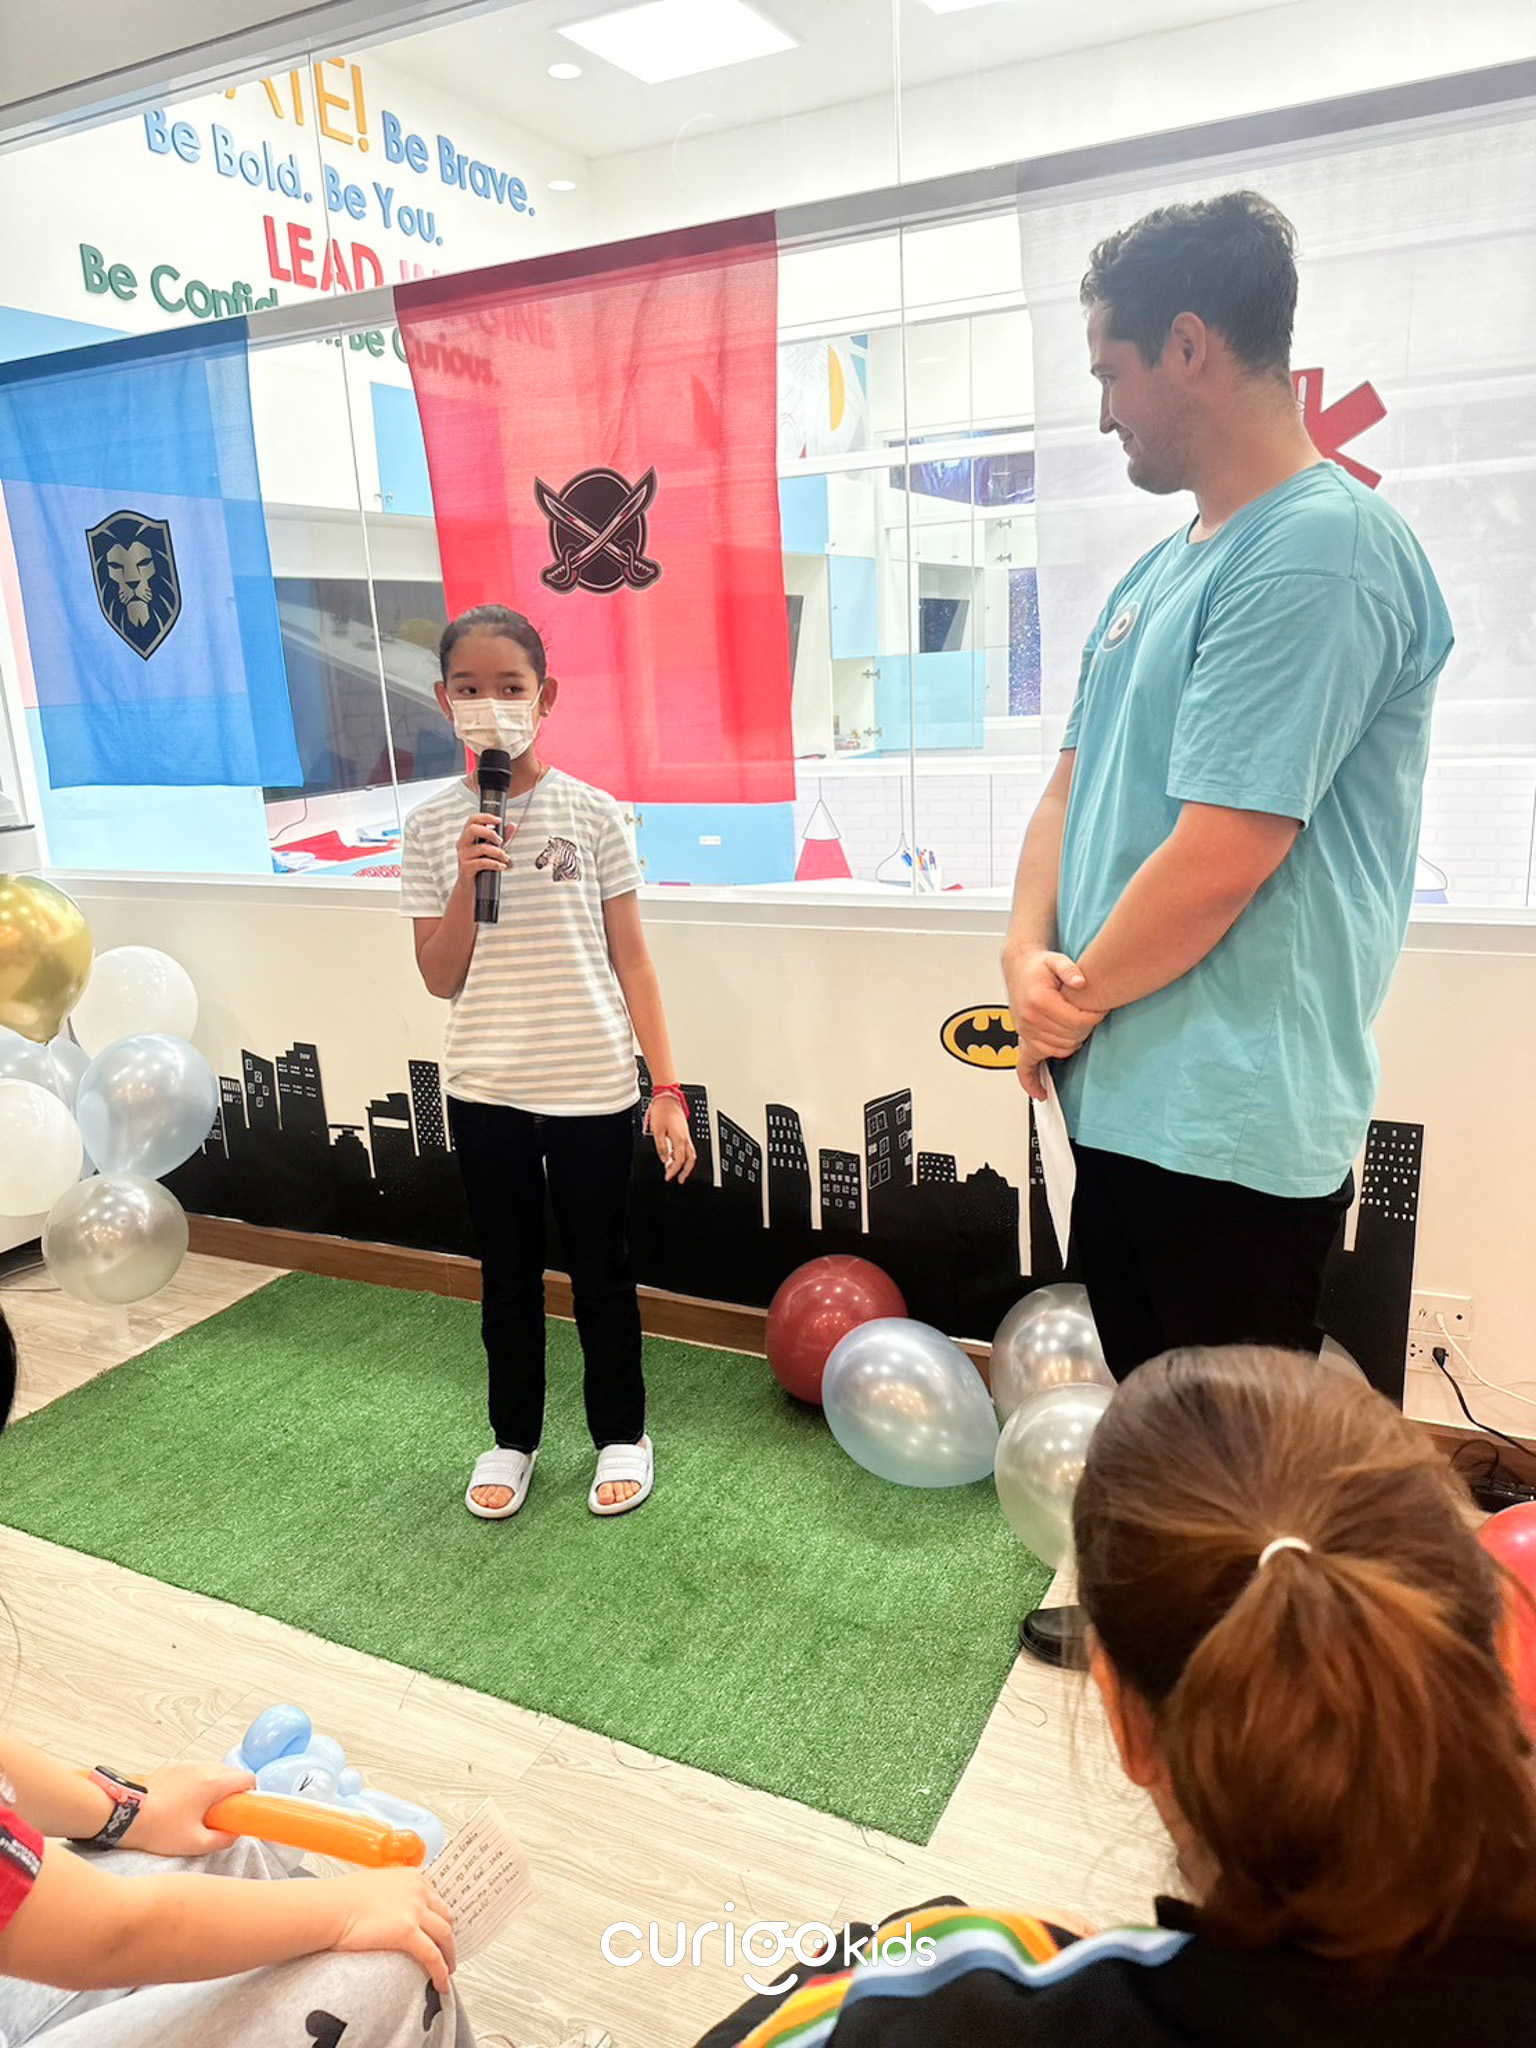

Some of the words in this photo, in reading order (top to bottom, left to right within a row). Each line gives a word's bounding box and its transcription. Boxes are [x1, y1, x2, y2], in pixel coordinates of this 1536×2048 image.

[144, 108, 201, 163] Be
[212, 123, 313, 203] Bold.
[324, 163, 367, 220] Be
[372, 181, 443, 246] You.
[382, 110, 429, 174] Be
[437, 134, 535, 216] Brave.
[79, 243, 138, 301] Be
[263, 215, 385, 293] LEAD
